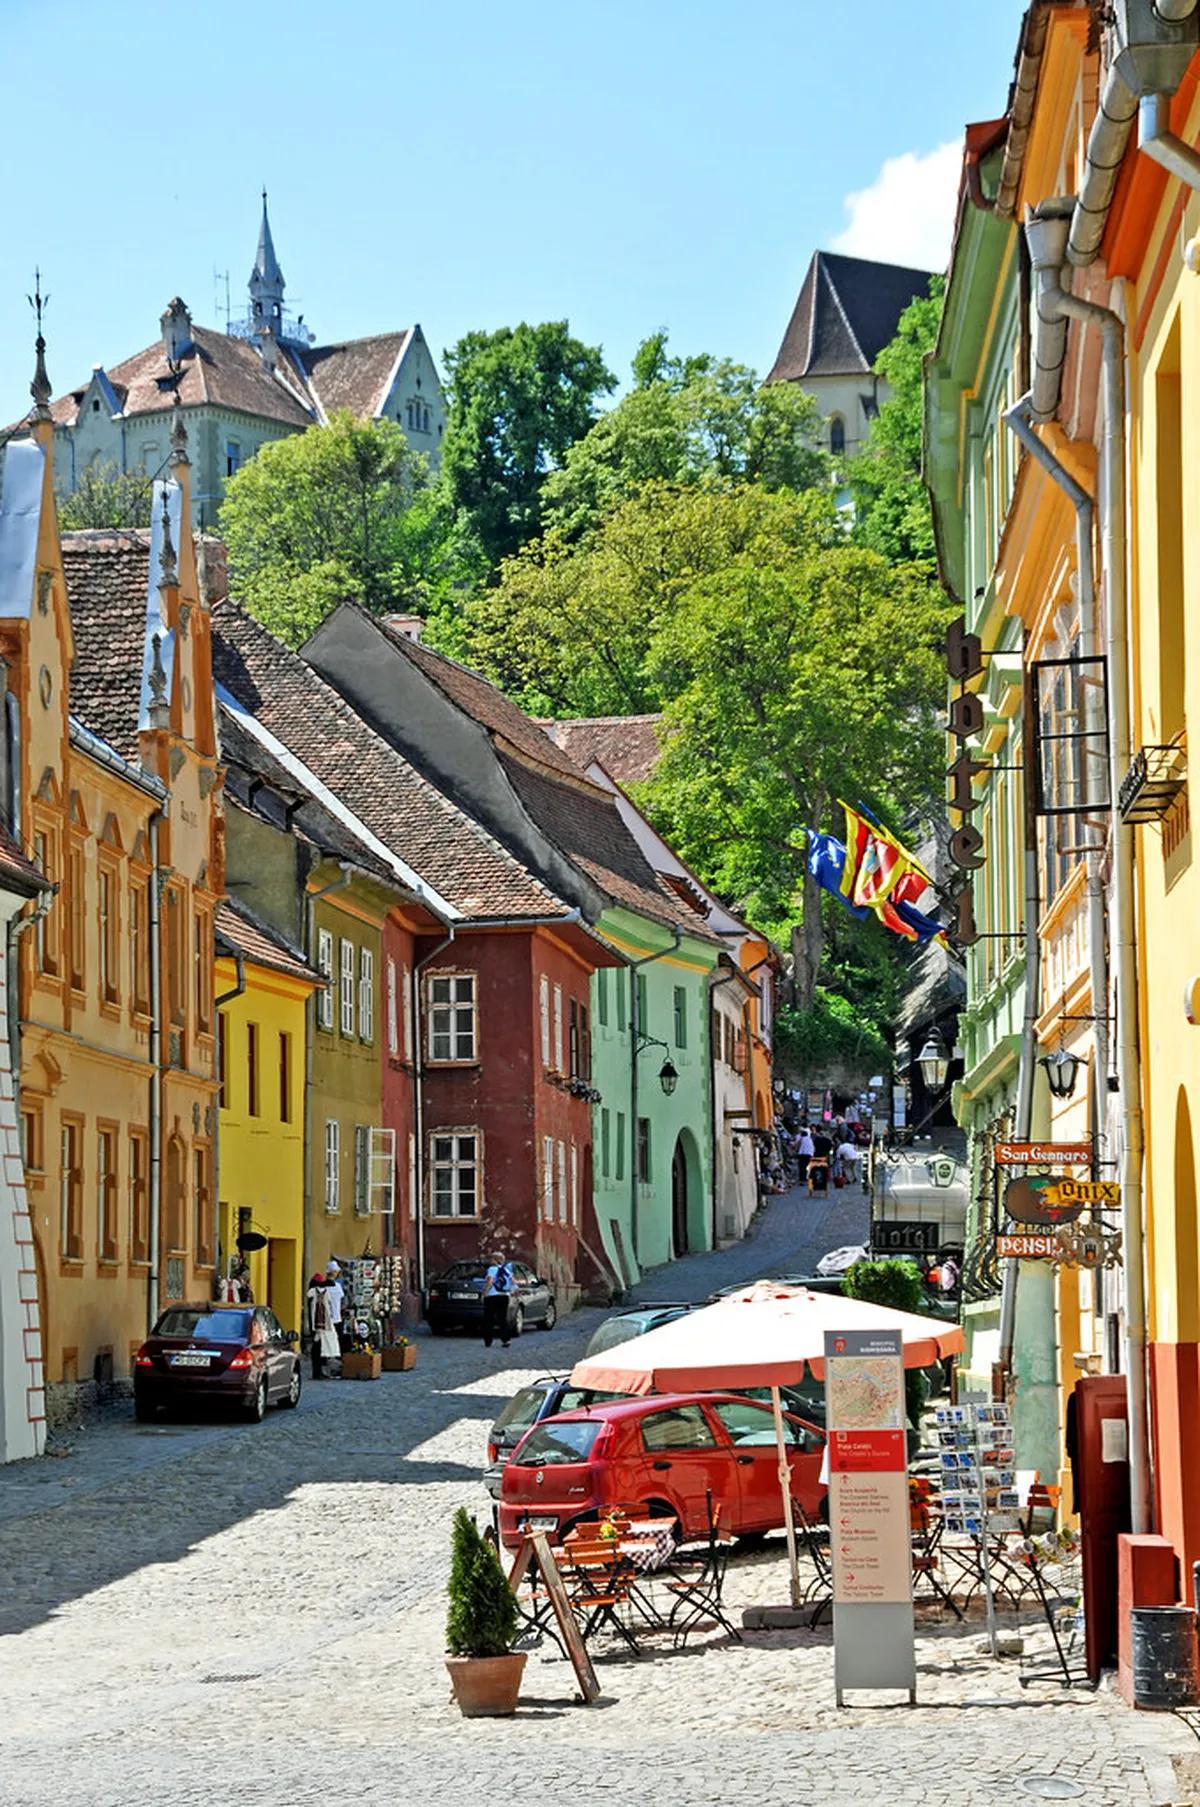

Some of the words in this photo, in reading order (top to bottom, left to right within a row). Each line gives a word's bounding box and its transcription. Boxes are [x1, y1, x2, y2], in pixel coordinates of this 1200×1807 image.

[943, 615, 988, 946] hotel
[1001, 1146, 1029, 1161] San
[1030, 1146, 1089, 1162] Gennaro
[874, 1224, 936, 1248] hotel
